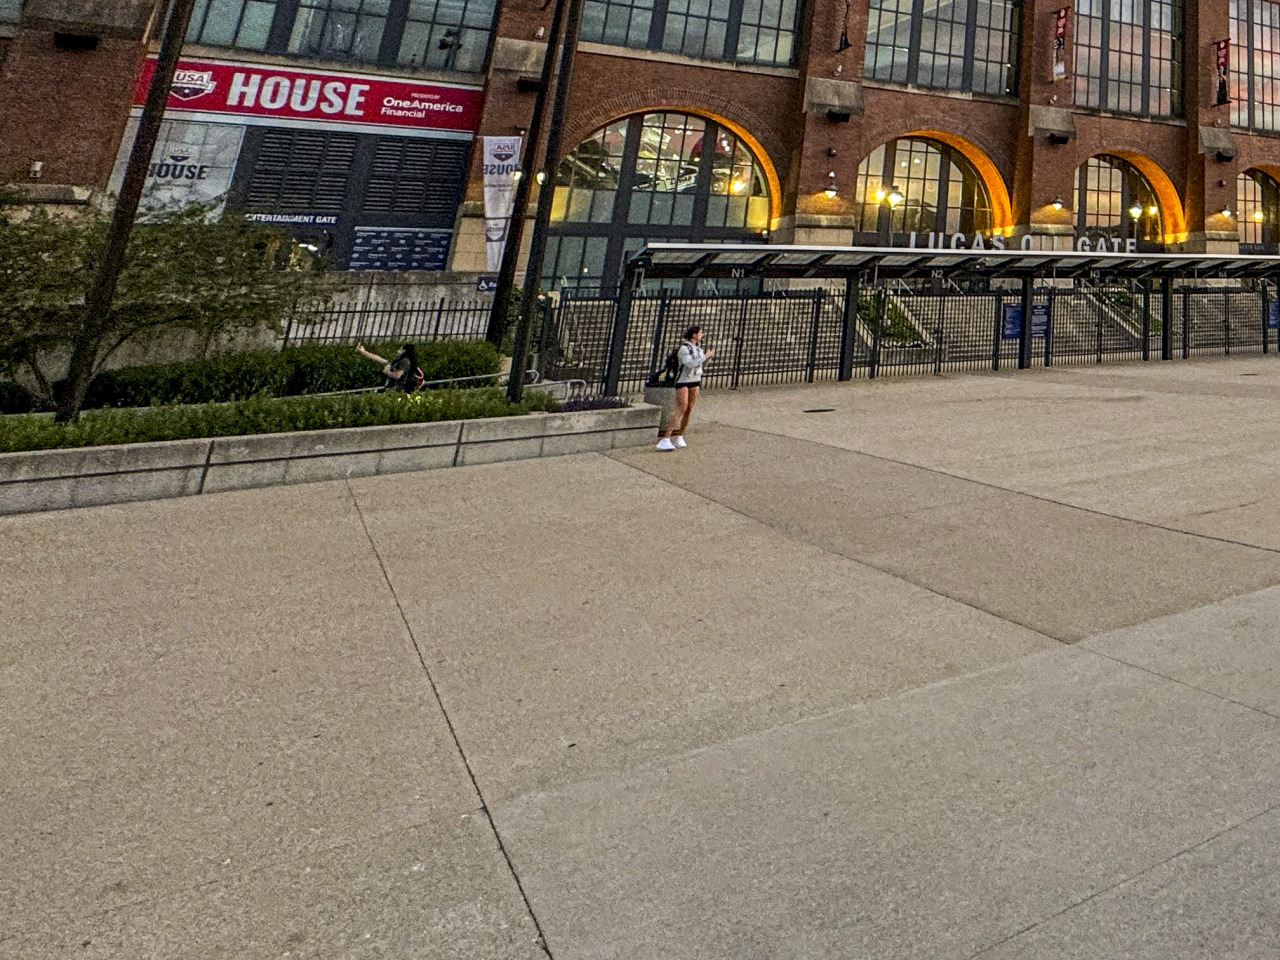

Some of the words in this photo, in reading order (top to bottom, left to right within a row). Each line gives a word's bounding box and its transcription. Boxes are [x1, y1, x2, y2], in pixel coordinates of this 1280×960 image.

[175, 72, 204, 83] USA
[226, 72, 370, 117] HOUSE
[383, 97, 464, 113] OneAmerica
[380, 107, 426, 118] Financial
[315, 215, 338, 224] GATE
[1077, 236, 1137, 253] GATE
[931, 269, 944, 279] N2
